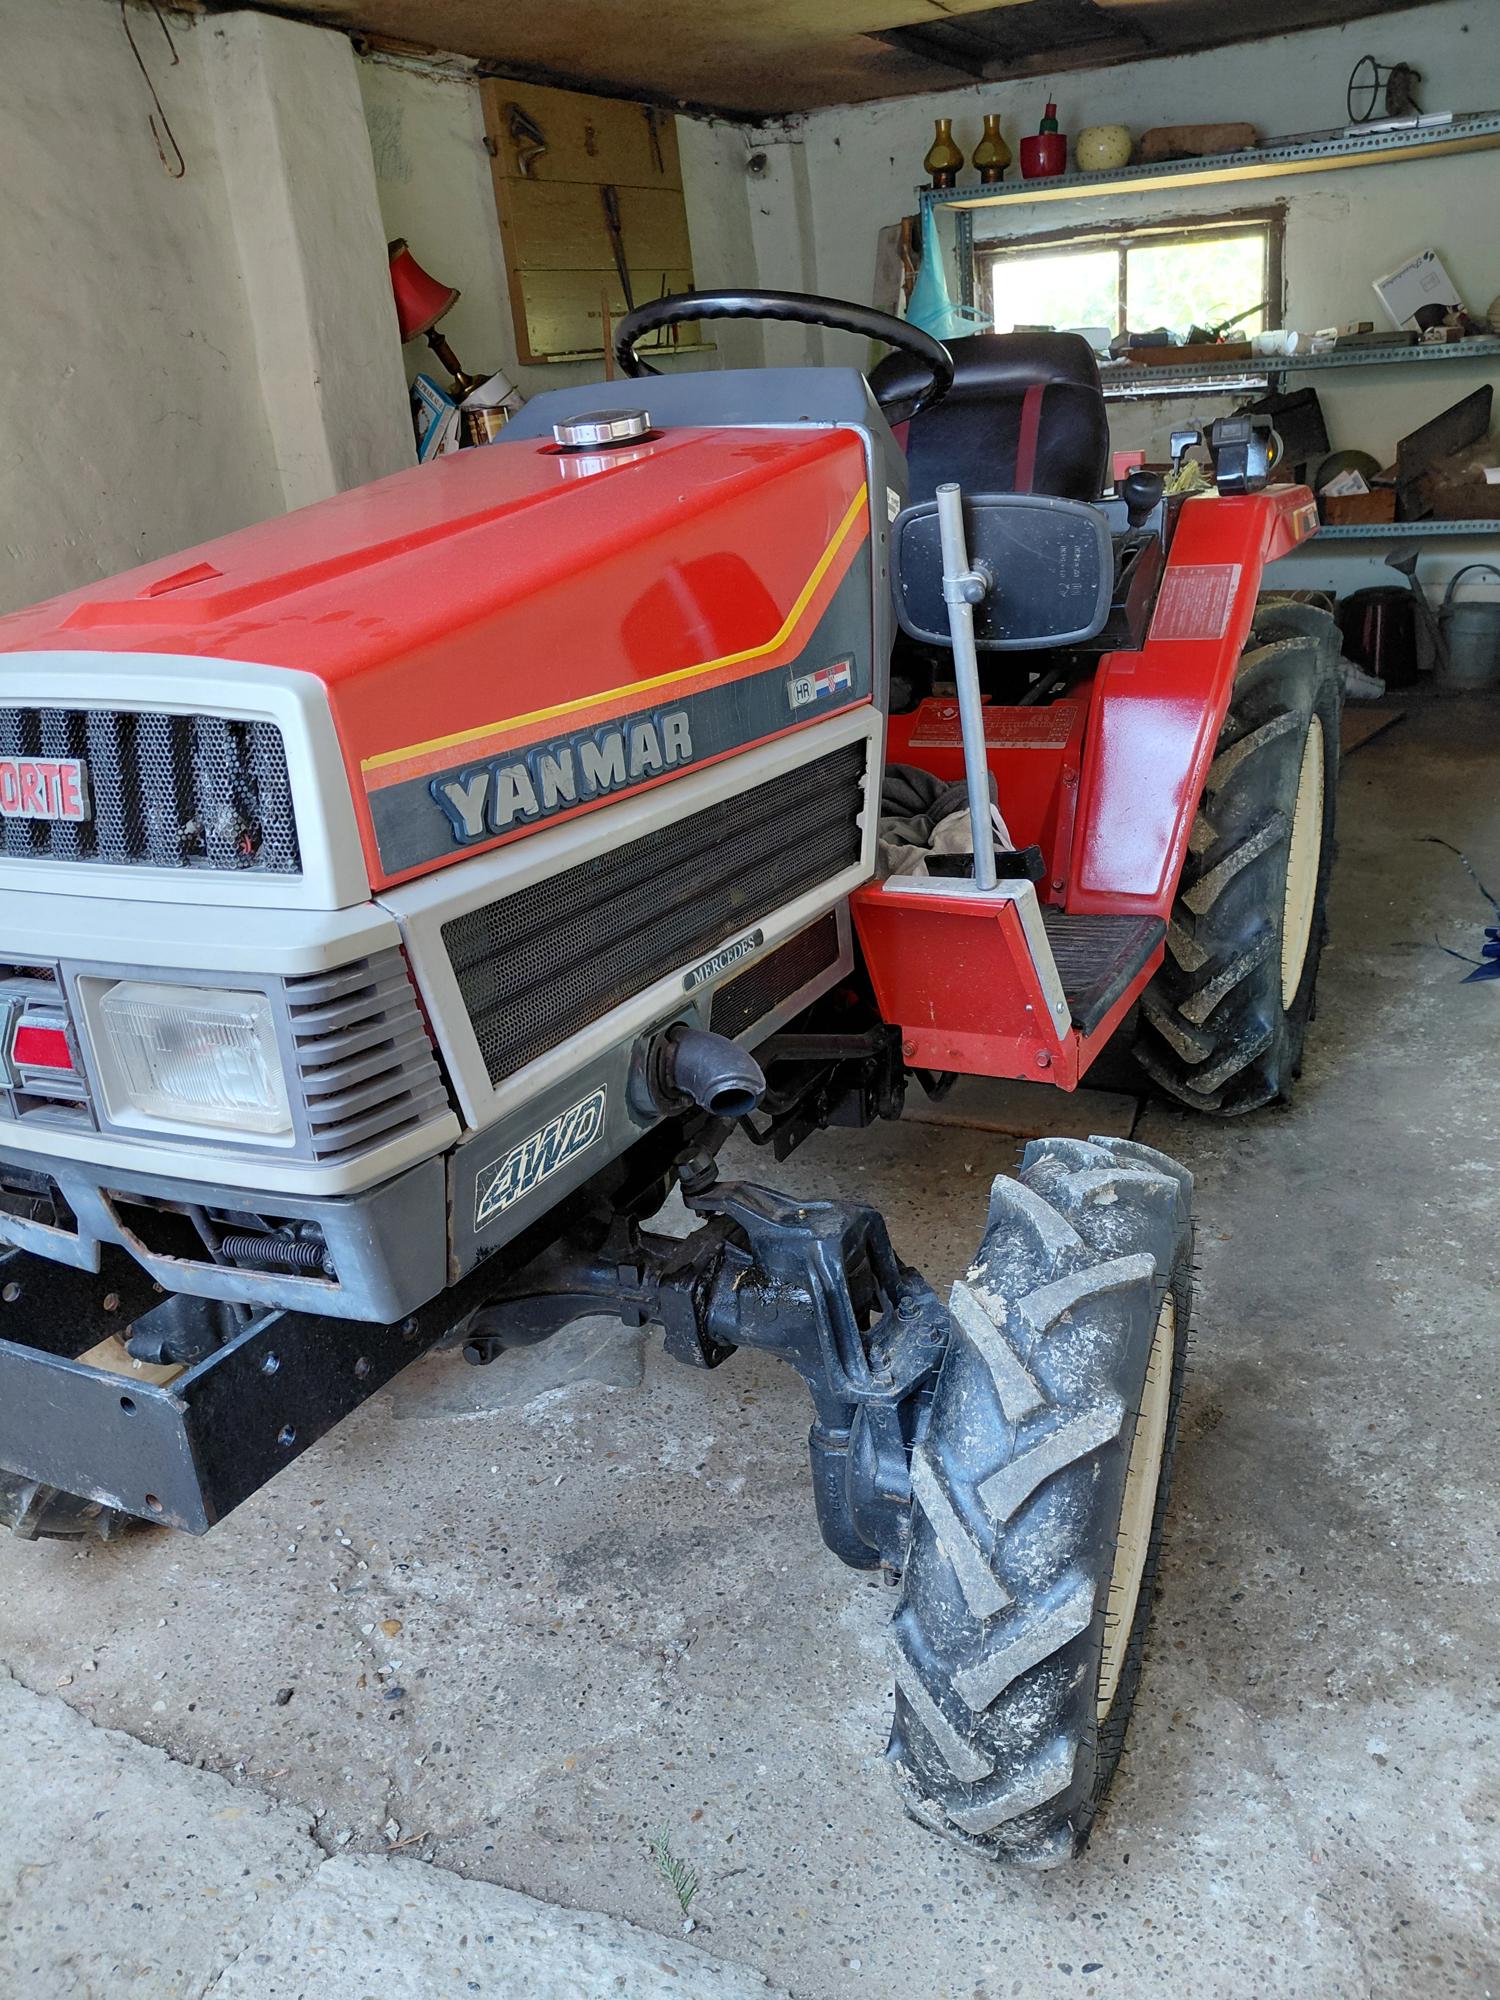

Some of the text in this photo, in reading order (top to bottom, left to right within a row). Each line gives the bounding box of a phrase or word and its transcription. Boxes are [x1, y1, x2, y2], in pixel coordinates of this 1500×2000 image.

[796, 683, 810, 700] HR
[438, 708, 694, 840] YANMAR
[692, 935, 756, 985] MERCEDES
[477, 1090, 605, 1222] 4WD
